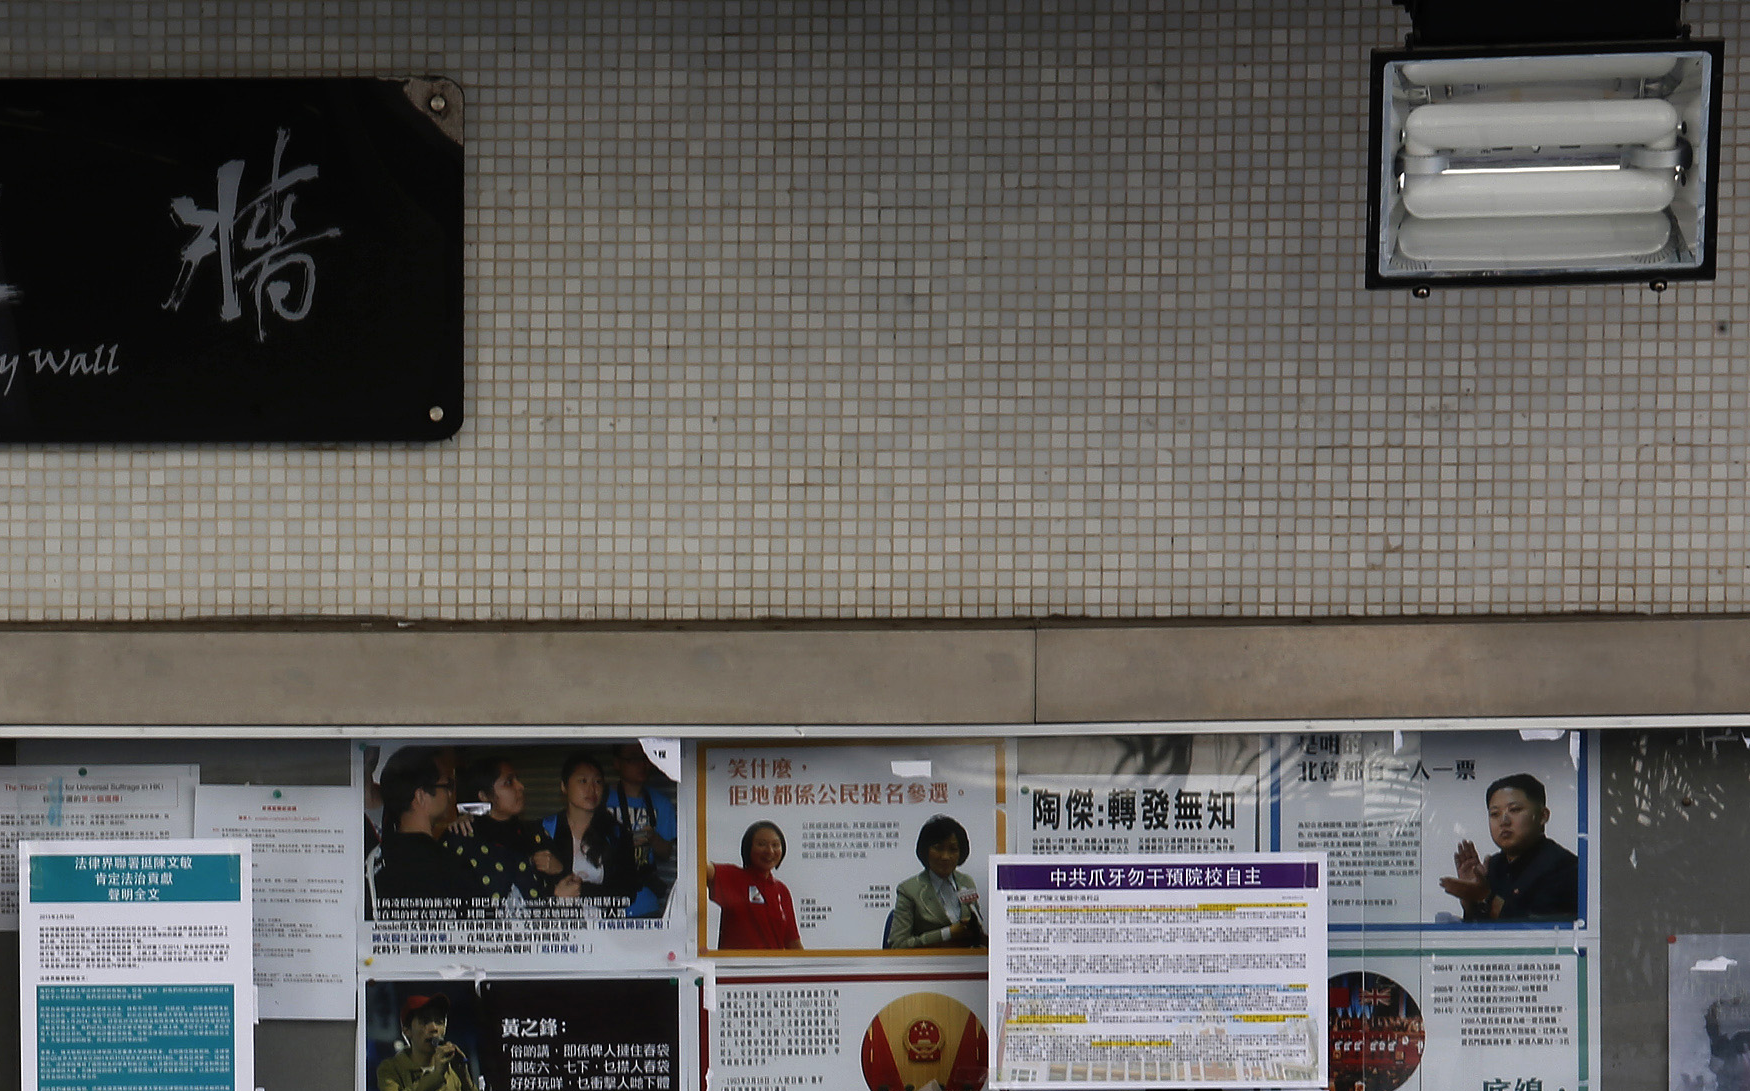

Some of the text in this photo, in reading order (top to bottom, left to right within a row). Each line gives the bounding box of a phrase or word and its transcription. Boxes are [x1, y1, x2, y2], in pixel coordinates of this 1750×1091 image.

[31, 343, 120, 376] Wall
[76, 783, 110, 792] Universal
[728, 782, 965, 806] 佢地都係公民提名參選。
[75, 856, 193, 870] 法律界聯署挺陳文敏
[95, 872, 173, 886] 肯定法治貢獻
[1051, 867, 1262, 888] 中共爪牙勿干預院校自主
[108, 888, 160, 901] 聲明全文
[502, 1018, 567, 1038] 黃之鋒：
